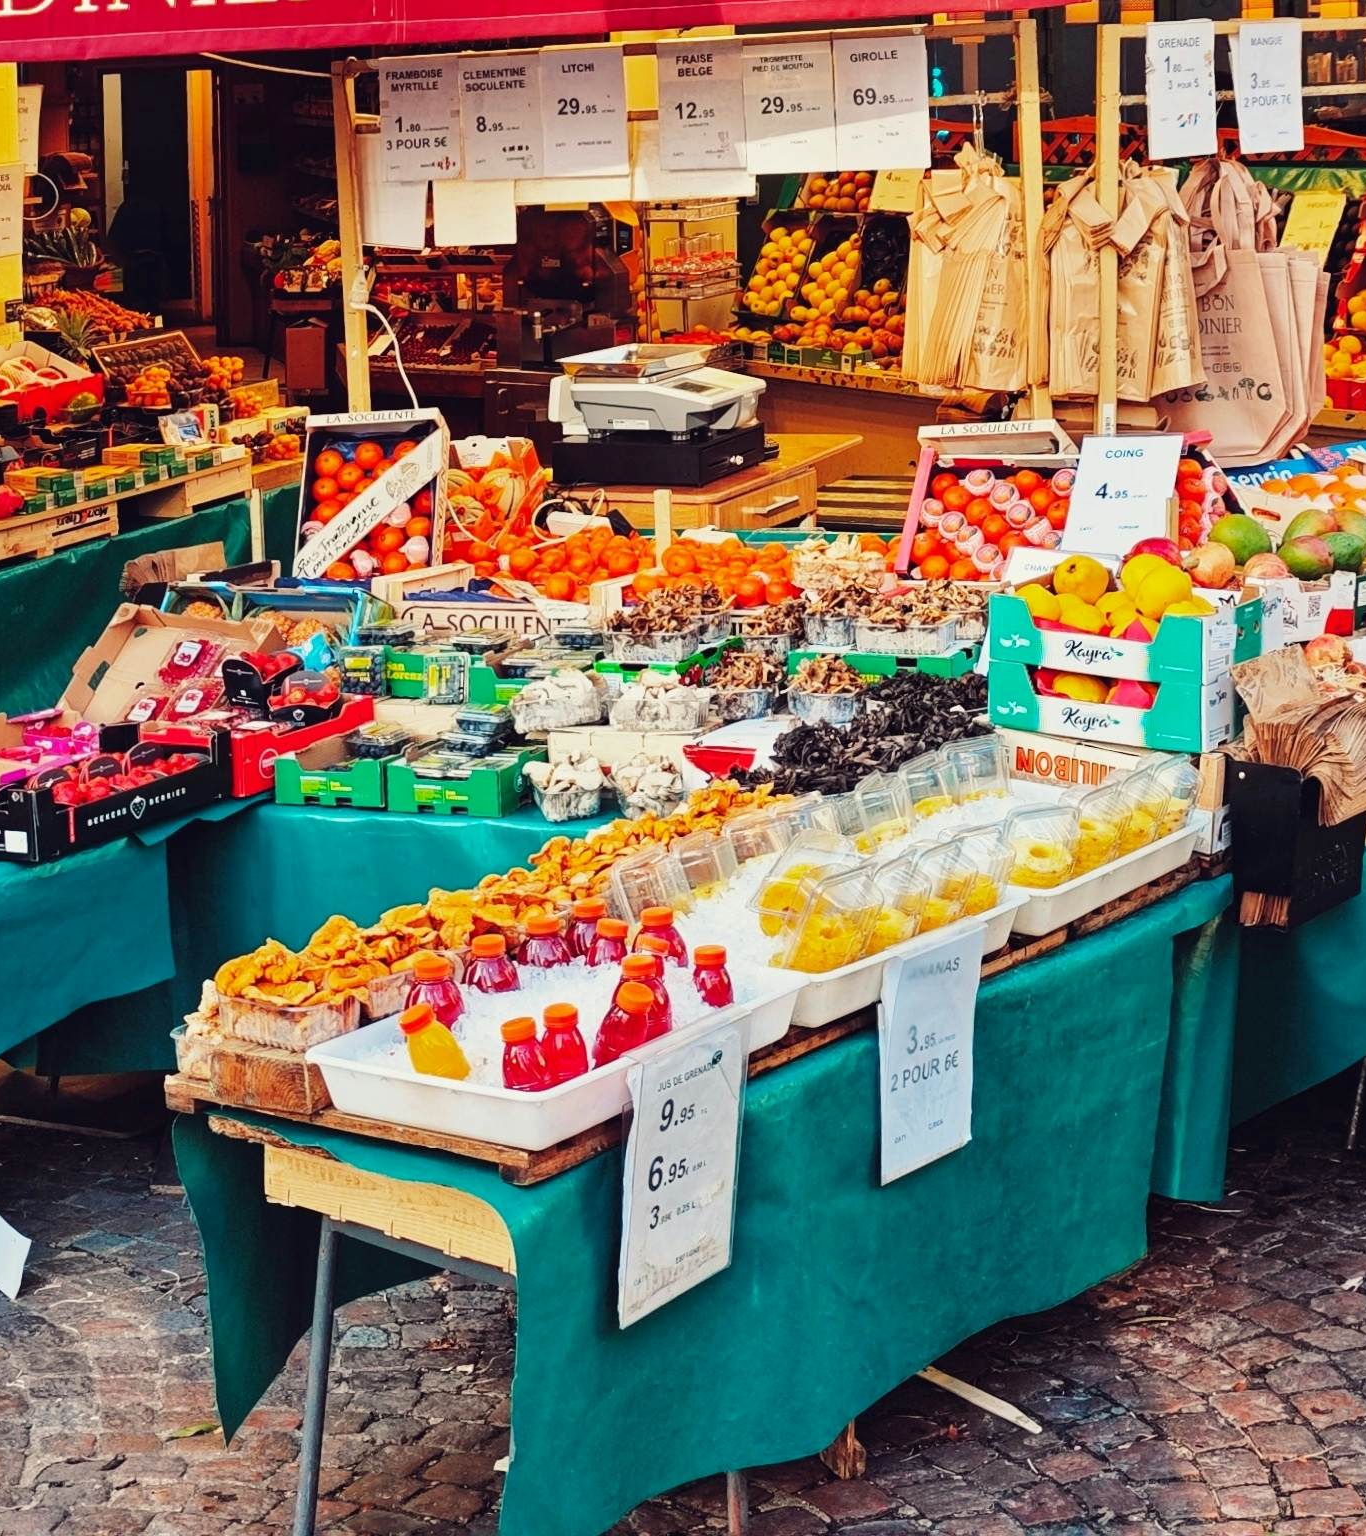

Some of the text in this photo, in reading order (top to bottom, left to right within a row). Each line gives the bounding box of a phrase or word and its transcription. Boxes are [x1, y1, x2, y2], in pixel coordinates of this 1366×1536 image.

[1157, 36, 1201, 49] GRENADE
[675, 53, 714, 64] FRAISE
[849, 50, 898, 63] GIROLLE
[385, 68, 443, 81] FRAMBOISE
[462, 66, 527, 81] CLEMENTINE
[561, 63, 595, 74] LITCHI
[677, 66, 713, 77] BELGE
[390, 80, 439, 92] MYRTILLE
[465, 79, 526, 93] SOCULENTE
[852, 87, 896, 106] 69.95
[1243, 97, 1249, 108] 2
[1251, 95, 1280, 107] POUR
[557, 97, 597, 116] 29.95
[674, 101, 715, 120] 12.95
[760, 96, 803, 115] 29.95
[394, 116, 421, 133] 1.80
[475, 115, 504, 133] 8.95
[386, 136, 447, 151] 3 POUR 5€
[326, 410, 417, 424] LA SOCULENTE
[940, 421, 1034, 436] LA SOCULENTE
[1105, 448, 1144, 459] COING
[1095, 482, 1129, 500] 4.95
[1064, 639, 1113, 666] Kayra
[1061, 706, 1109, 733] Kayra
[905, 1024, 937, 1056] 3.95
[890, 1049, 960, 1093] 2 POUR 6€
[657, 1078, 672, 1092] JUS
[673, 1074, 684, 1087] DE
[659, 1098, 696, 1133] 9.95
